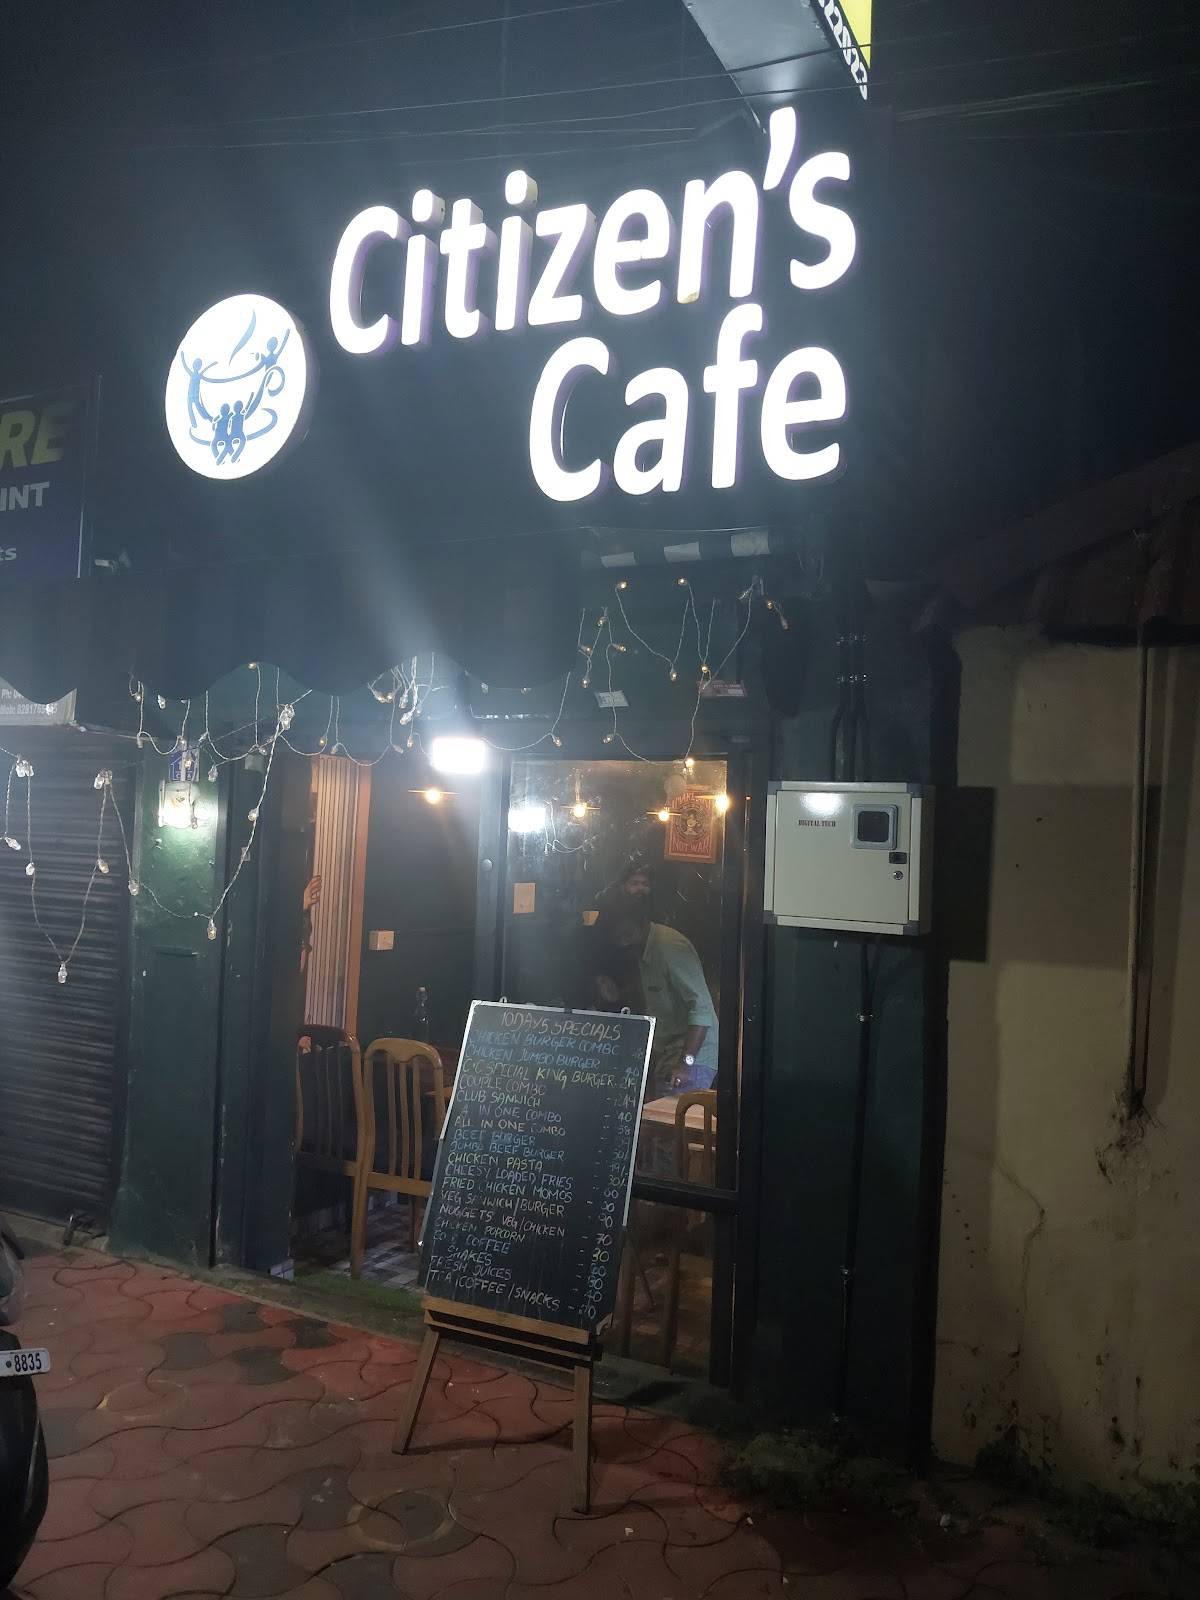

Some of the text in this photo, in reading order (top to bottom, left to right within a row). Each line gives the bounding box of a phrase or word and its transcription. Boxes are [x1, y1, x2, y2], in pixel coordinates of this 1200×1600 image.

[330, 106, 858, 354] Citizen's
[530, 303, 848, 502] Cafe
[549, 1019, 622, 1042] SPECIALS
[525, 1033, 576, 1052] BURGER
[555, 1053, 601, 1071] BURGER
[459, 1074, 502, 1091] COUPLE
[486, 1061, 530, 1081] SPECIAL
[535, 1067, 568, 1090] KING
[457, 1089, 487, 1104] CLUB
[454, 1114, 472, 1128] ALL
[480, 1119, 494, 1130] IN
[497, 1118, 526, 1133] ONE
[479, 1104, 491, 1117] IN
[525, 1110, 563, 1124] COMBO
[490, 1131, 537, 1147] BURGER
[447, 1152, 500, 1167] CHICKEN
[506, 1157, 544, 1172] PASTA
[523, 1149, 565, 1162] BURGER
[444, 1163, 491, 1180] CHEESY
[495, 1168, 538, 1185] LOADED
[540, 1174, 574, 1191] FRIES
[440, 1189, 462, 1205] VEG
[441, 1176, 475, 1192] FRIED
[532, 1184, 573, 1204] MOMOS
[439, 1203, 494, 1222] NUGGETS
[484, 1225, 526, 1242] POPCORN
[472, 1264, 512, 1281] JUICES
[14, 1352, 42, 1373] 8835
